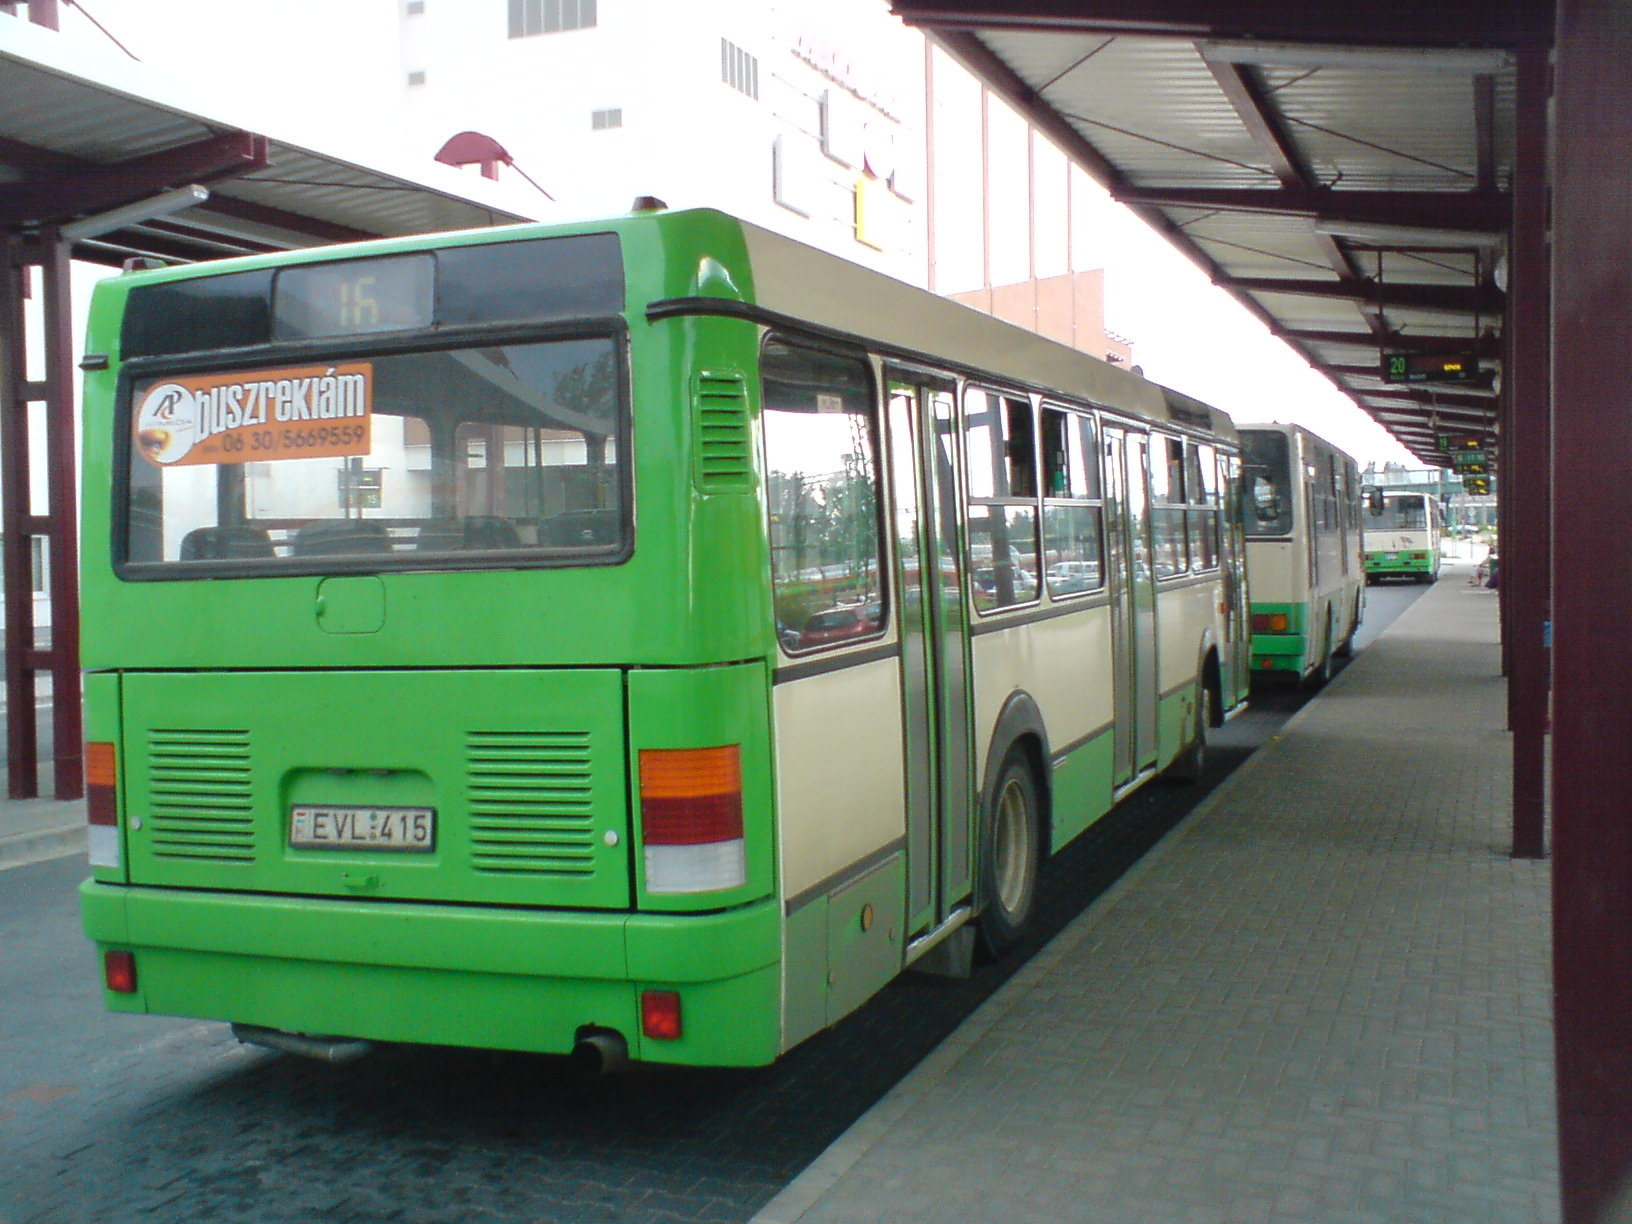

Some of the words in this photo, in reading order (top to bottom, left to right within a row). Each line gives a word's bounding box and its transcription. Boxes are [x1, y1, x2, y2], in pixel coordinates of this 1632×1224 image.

[1390, 357, 1406, 373] 20
[194, 367, 365, 445] buszreklám
[222, 433, 244, 452] 06
